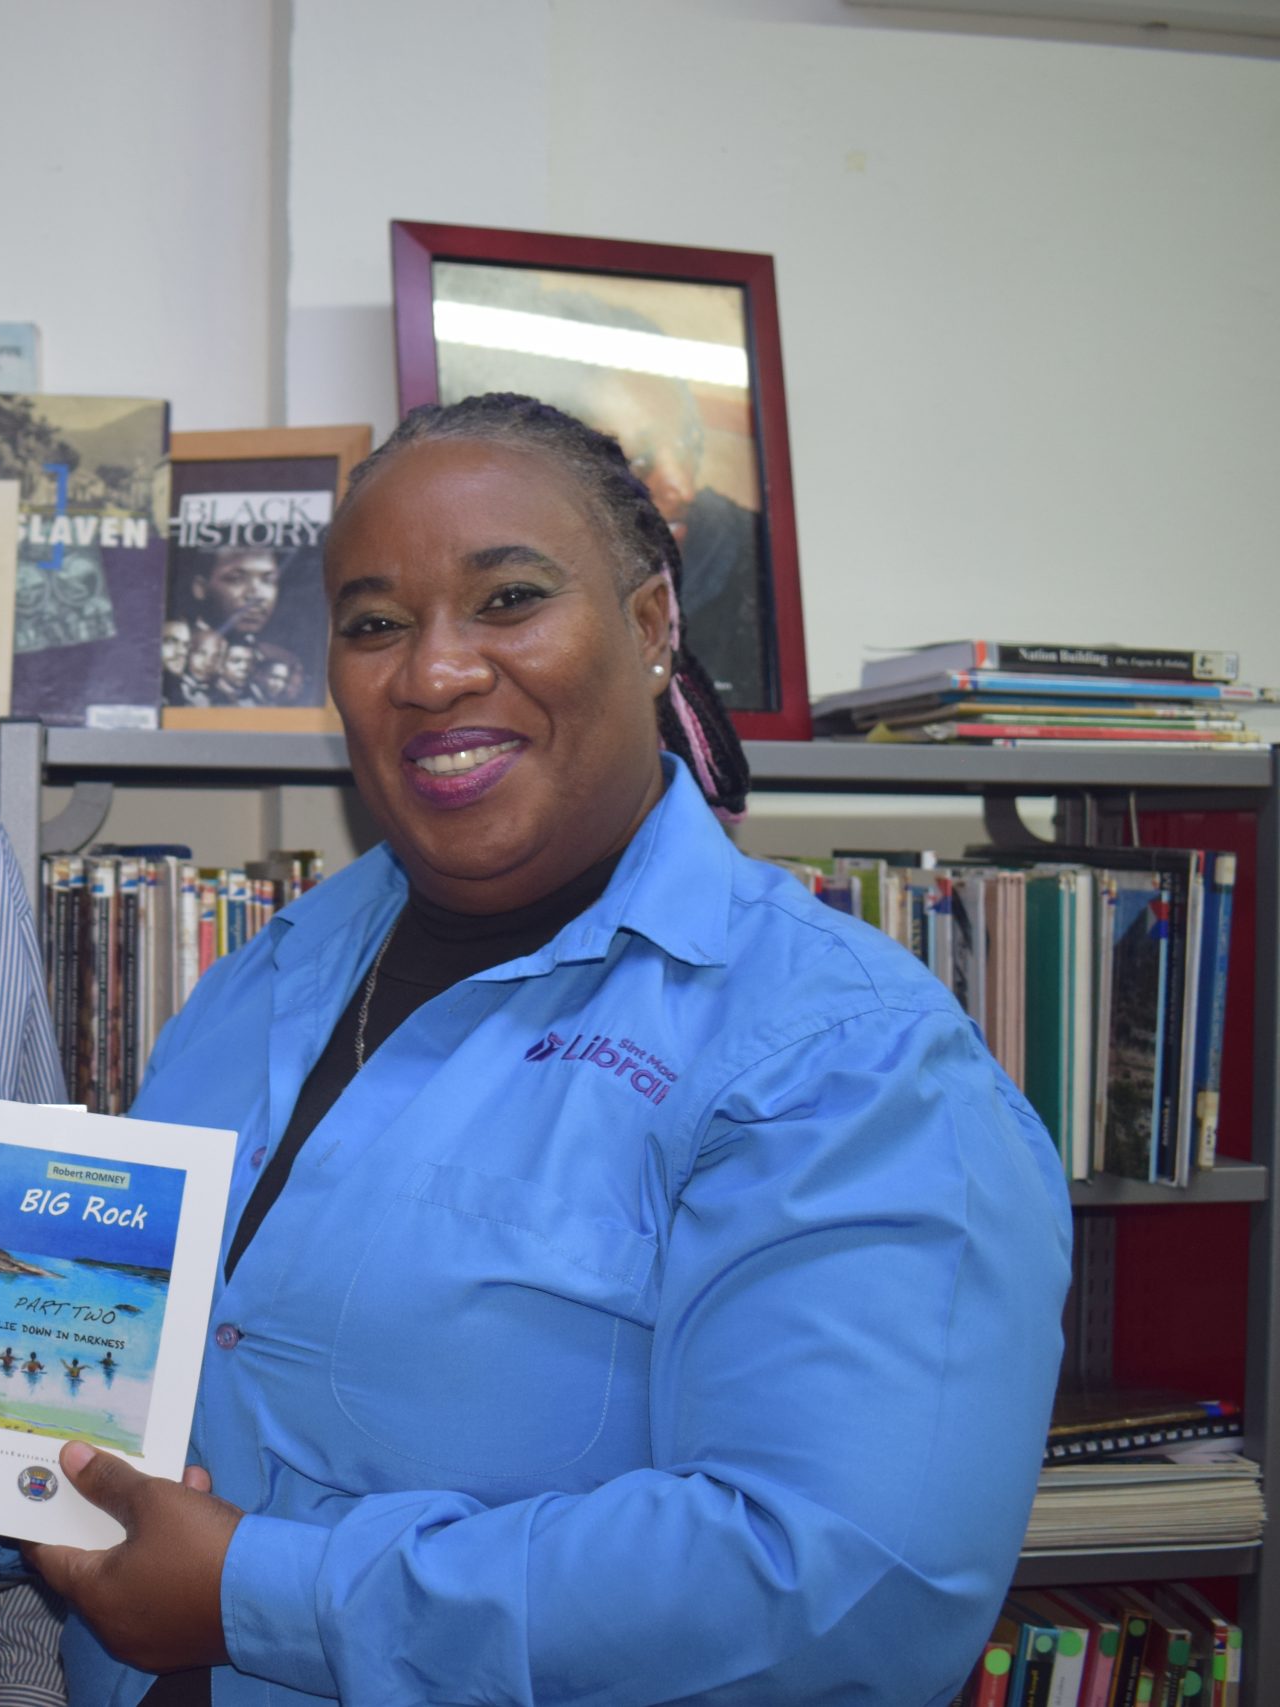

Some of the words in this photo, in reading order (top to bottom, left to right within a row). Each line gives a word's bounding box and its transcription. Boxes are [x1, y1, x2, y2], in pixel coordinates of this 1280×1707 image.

[184, 497, 316, 526] BLACK
[167, 517, 322, 548] HISTORY
[1020, 648, 1058, 663] Nation
[1060, 650, 1109, 667] Building
[618, 1038, 647, 1061] Sint
[52, 1166, 83, 1179] Robert
[85, 1171, 126, 1184] ROMNEY
[20, 1188, 71, 1216] BIG
[82, 1195, 148, 1230] Rock
[14, 1296, 70, 1318] PART
[72, 1306, 117, 1325] TWO
[22, 1324, 52, 1337] DOWN
[55, 1330, 70, 1340] IN
[73, 1333, 126, 1350] DARKNESS
